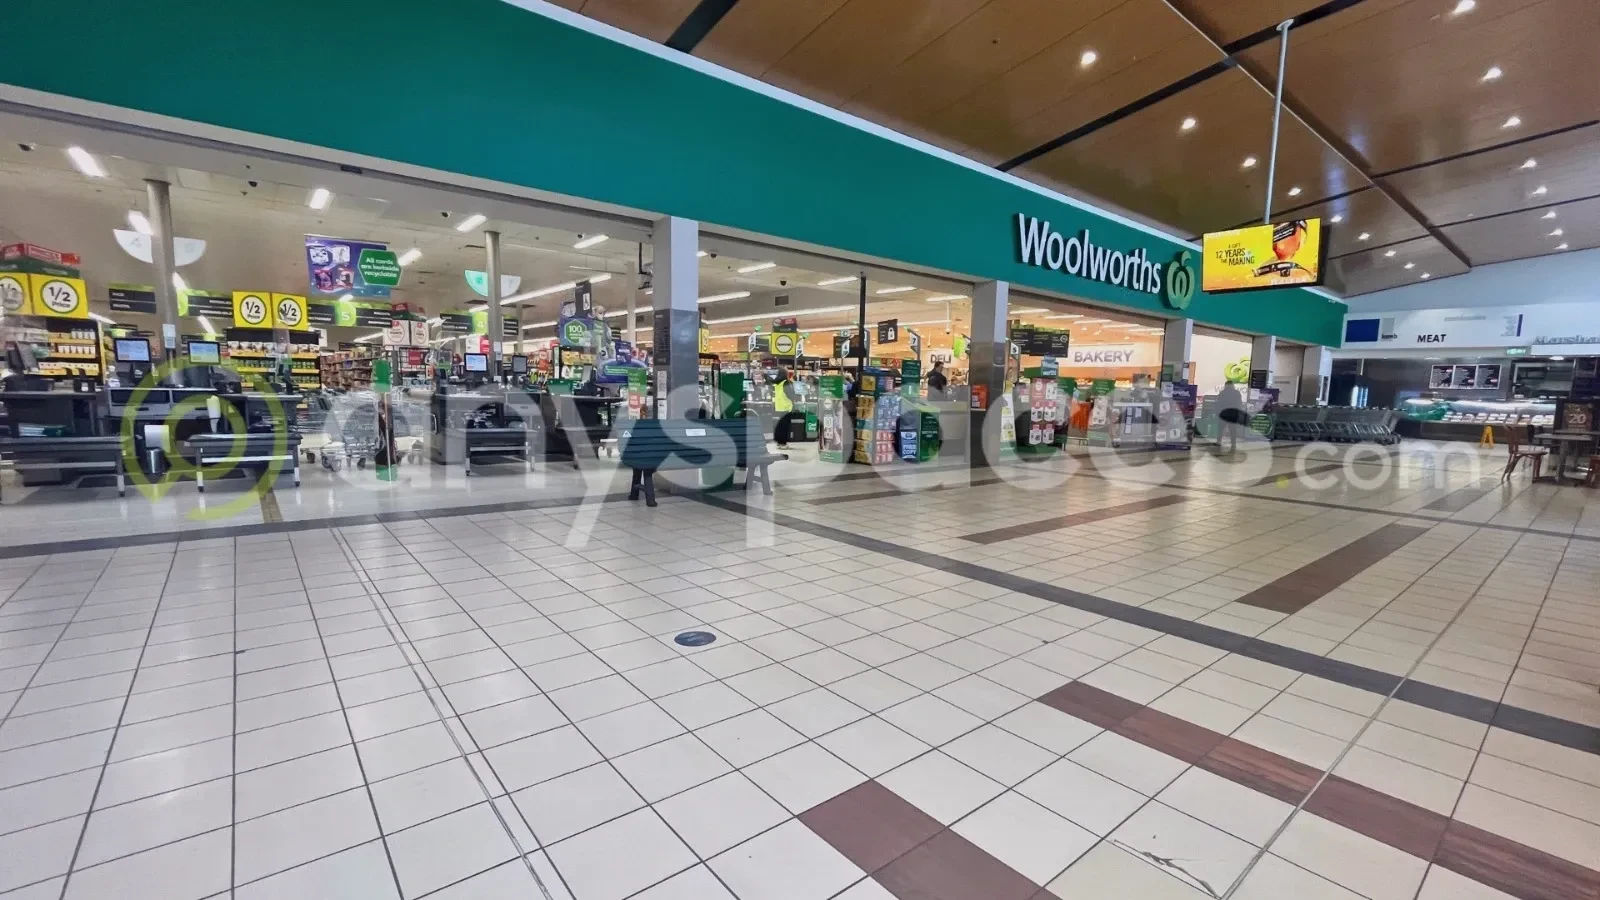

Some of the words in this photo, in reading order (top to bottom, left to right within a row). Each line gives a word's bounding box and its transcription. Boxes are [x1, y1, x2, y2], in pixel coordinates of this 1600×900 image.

[1018, 212, 1161, 294] Woolworths
[1216, 251, 1223, 259] 12
[1225, 247, 1246, 258] YEARS
[1229, 255, 1256, 266] MAKING
[364, 270, 397, 278] recyclable
[48, 286, 71, 302] 1/2
[245, 301, 260, 314] 1/2
[283, 303, 297, 317] 1/2
[341, 311, 351, 321] 5
[568, 325, 583, 333] 100
[1417, 333, 1447, 343] MEAT
[930, 353, 951, 363] DELI
[1074, 349, 1134, 363] BAKERY
[1568, 413, 1587, 424] 20
